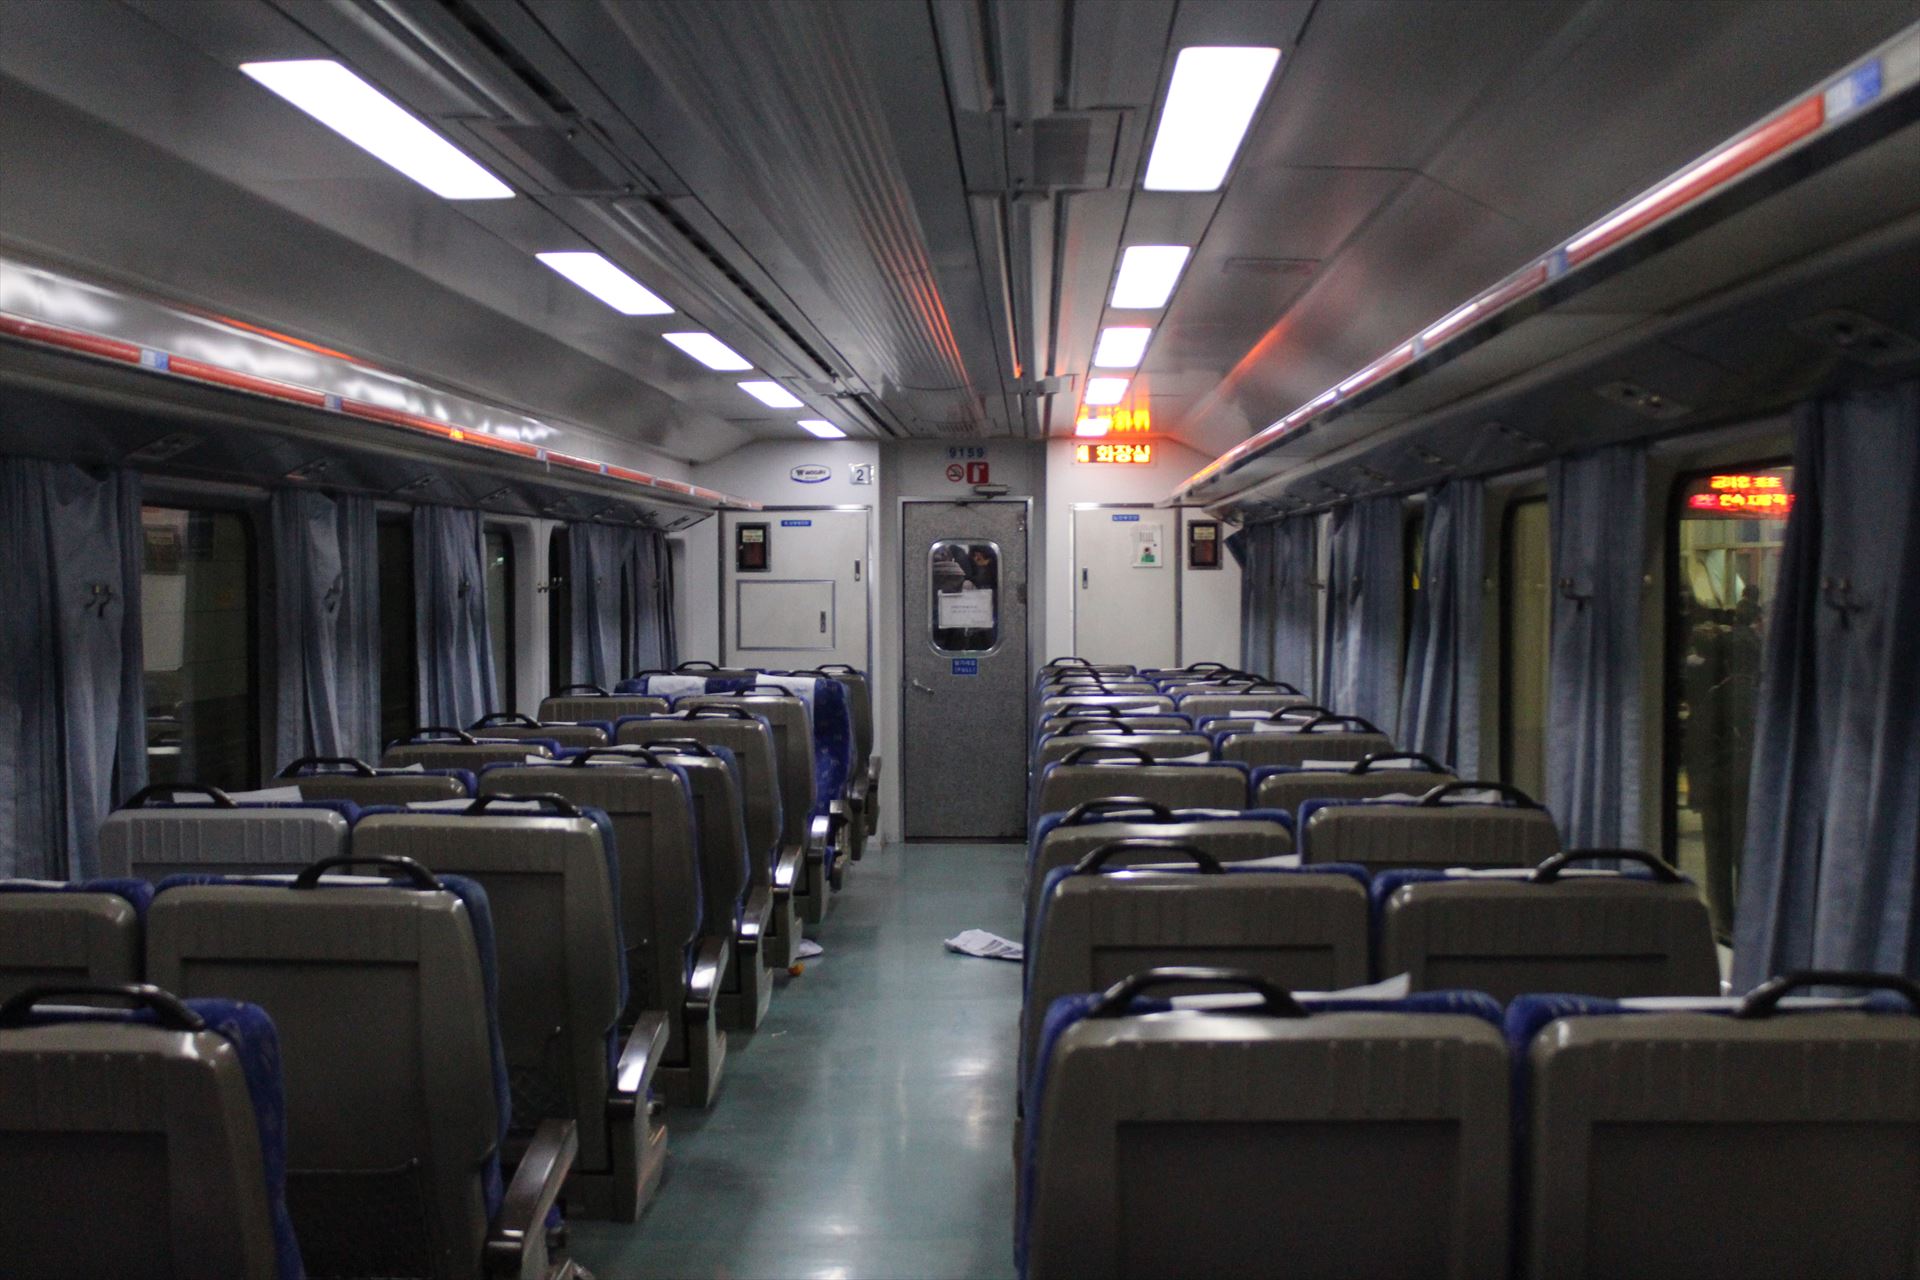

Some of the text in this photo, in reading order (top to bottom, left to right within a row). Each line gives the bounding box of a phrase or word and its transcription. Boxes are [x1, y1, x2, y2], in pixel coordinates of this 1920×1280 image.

[948, 447, 985, 458] 9159
[1096, 444, 1151, 463] 화장실
[856, 469, 864, 481] 2
